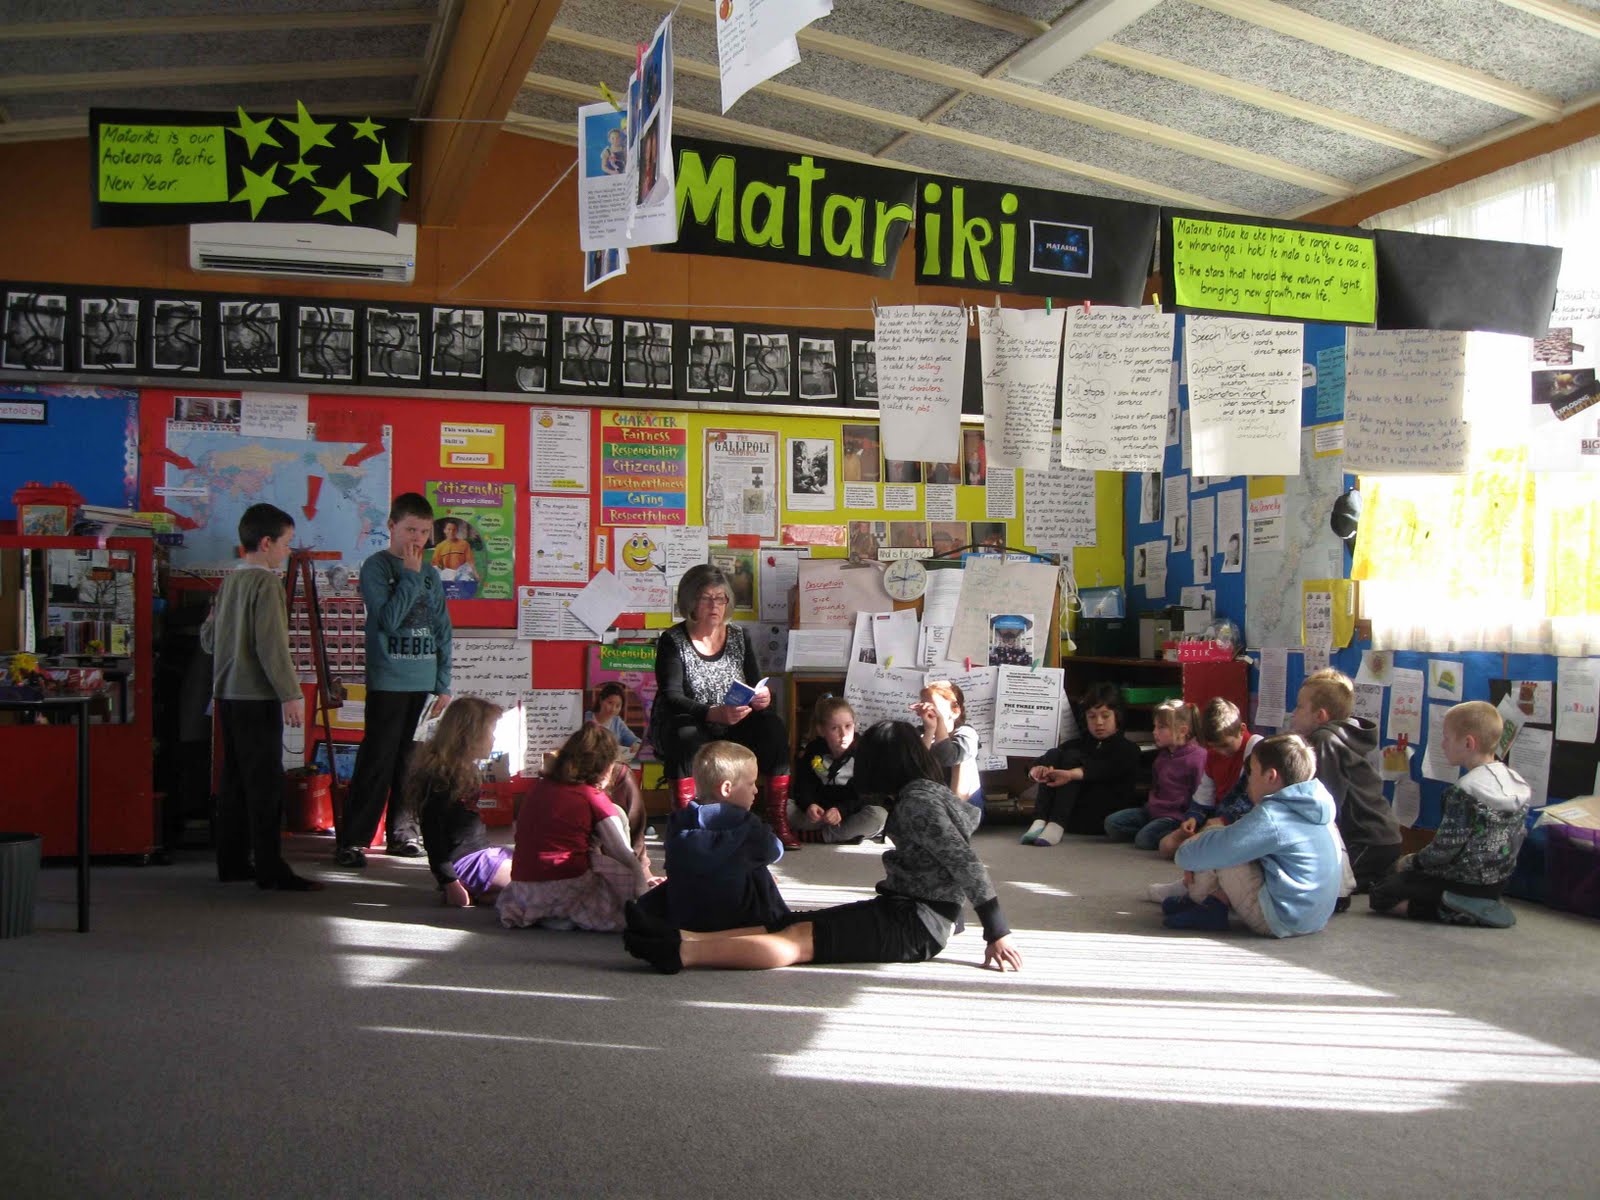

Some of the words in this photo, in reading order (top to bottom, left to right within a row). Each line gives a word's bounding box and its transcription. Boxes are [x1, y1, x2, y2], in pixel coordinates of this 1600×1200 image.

[103, 125, 160, 145] Matariki
[168, 132, 178, 145] is
[189, 133, 215, 145] our
[102, 149, 163, 165] Aotearoa
[171, 150, 216, 166] Pacific
[103, 173, 134, 191] New
[1177, 219, 1213, 236] Matariki
[1046, 242, 1079, 253] MATARIKI
[1177, 240, 1184, 250] e
[1177, 261, 1186, 276] To
[1189, 264, 1201, 276] the
[1205, 265, 1225, 278] stars
[1229, 267, 1246, 279] that
[1280, 272, 1293, 283] the
[1297, 274, 1321, 286] return
[1324, 275, 1335, 286] of
[1200, 281, 1239, 305] bringing
[1244, 287, 1261, 297] new
[1191, 328, 1222, 344] Speech
[1275, 330, 1298, 339] spoken
[32, 405, 44, 417] by
[1555, 394, 1589, 416] EXPLODING
[612, 412, 678, 428] CHARACTER
[620, 427, 671, 442] Fairness
[610, 443, 680, 459] Responsibility
[714, 440, 770, 454] GALLIPOLI
[1582, 440, 1600, 449] BIG
[612, 460, 679, 474] Citizenship
[436, 481, 505, 498] Citizenship
[605, 475, 685, 489] Trustworthiness
[627, 492, 664, 508] Caring
[609, 509, 681, 522] Respectfulness
[804, 580, 844, 590] Description
[567, 592, 579, 600] Angr
[387, 636, 436, 655] REBEL
[600, 645, 657, 660] Responsibili
